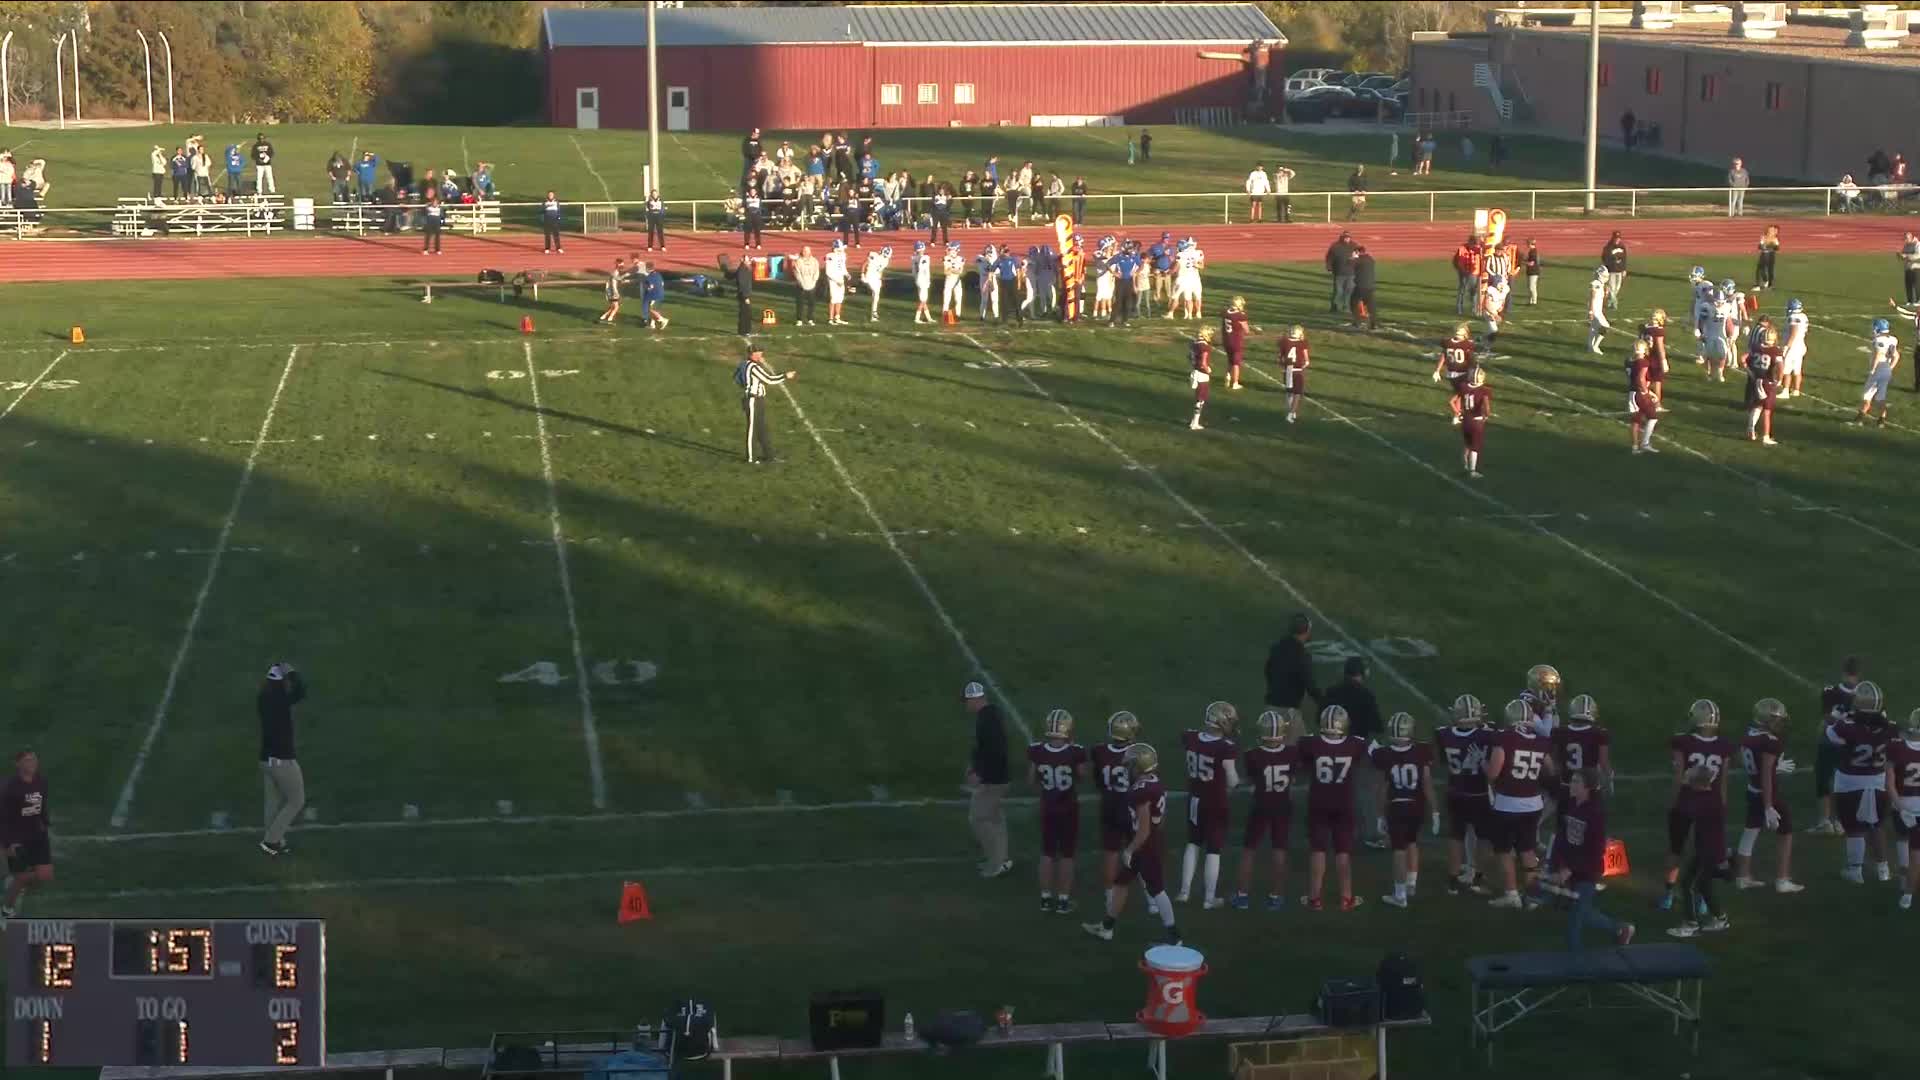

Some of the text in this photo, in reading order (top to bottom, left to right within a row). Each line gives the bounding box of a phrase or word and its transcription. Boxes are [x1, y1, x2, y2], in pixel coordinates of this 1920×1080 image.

[1288, 347, 1297, 363] 4
[1511, 750, 1544, 780] 55
[1566, 743, 1583, 769] 3
[1038, 764, 1073, 791] 36
[1102, 765, 1130, 792] 13
[1263, 763, 1290, 792] 15
[1315, 756, 1352, 784] 67
[1391, 763, 1418, 790] 10
[1163, 982, 1184, 1004] G
